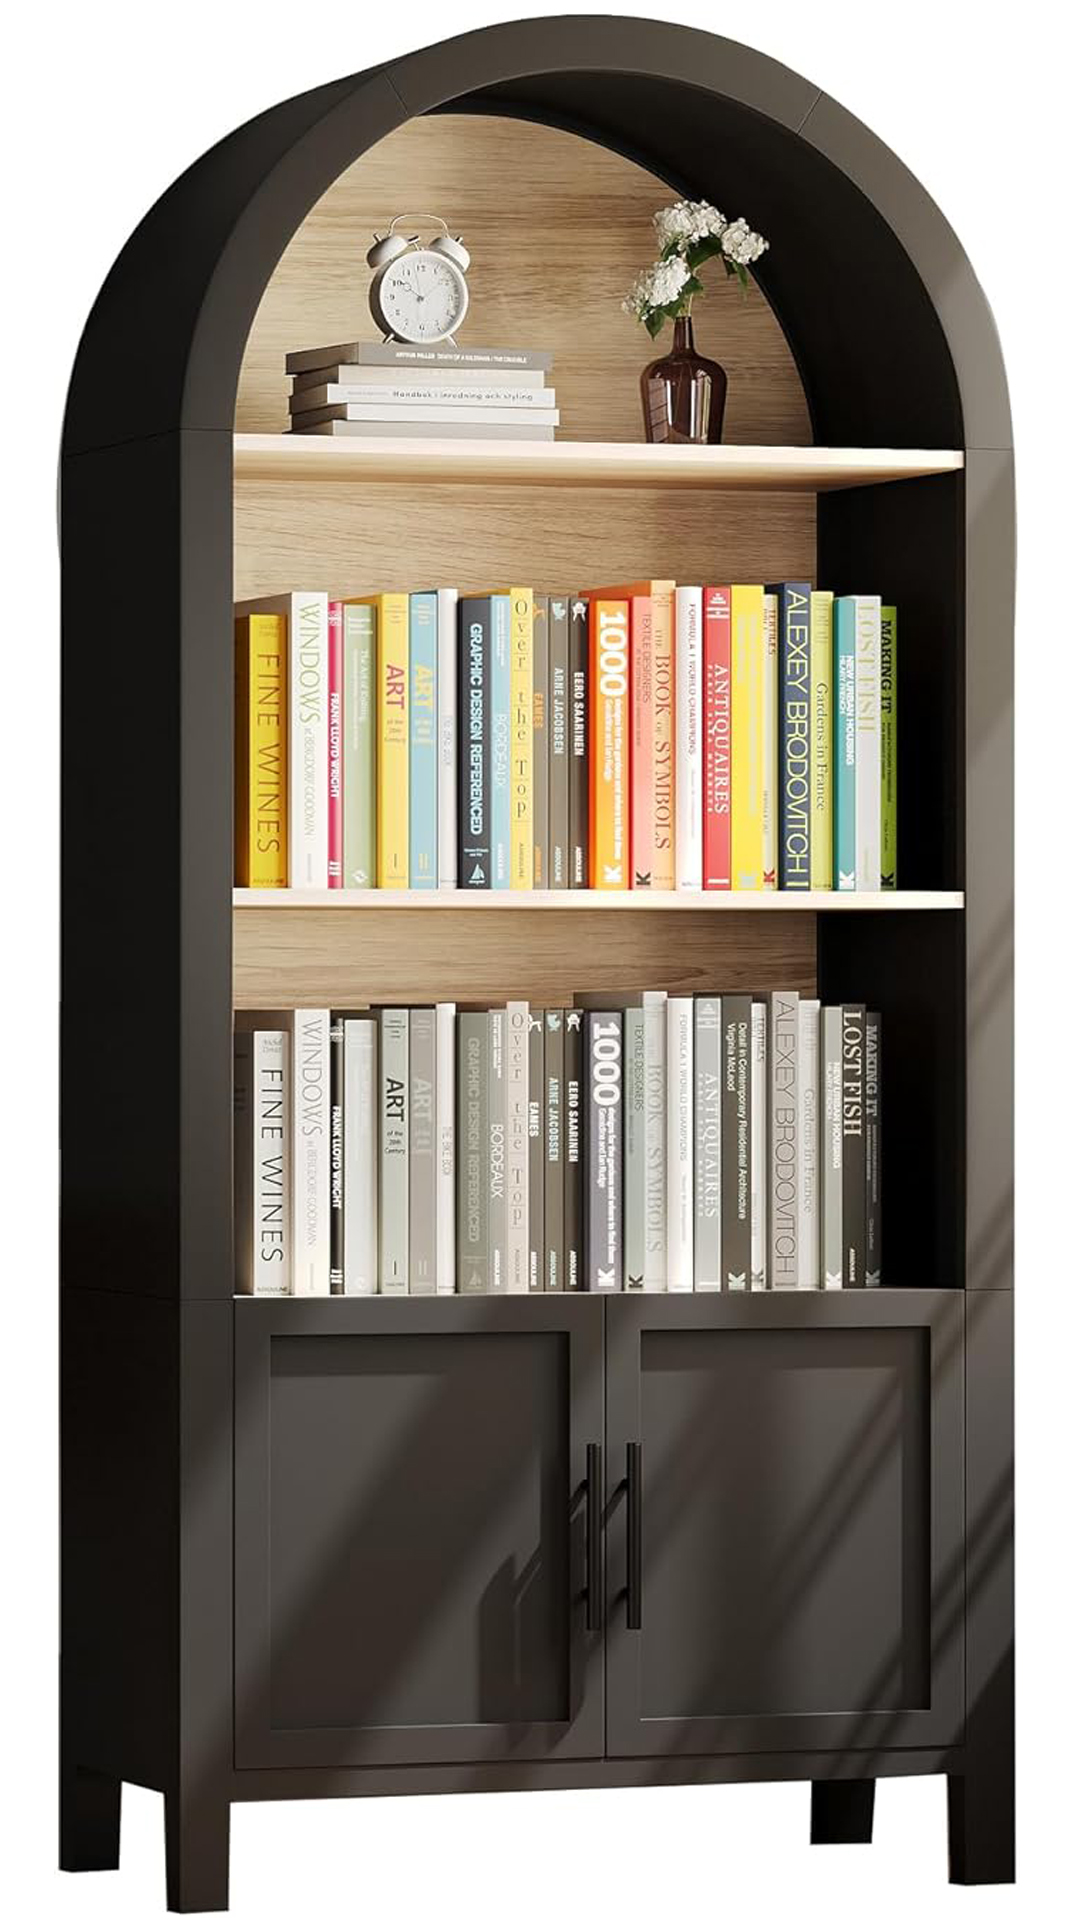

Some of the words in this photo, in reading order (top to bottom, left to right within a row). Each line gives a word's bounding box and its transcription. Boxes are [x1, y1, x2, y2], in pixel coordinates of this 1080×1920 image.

[642, 613, 652, 649] TEXTILE
[687, 603, 696, 650] FORMULA
[787, 590, 808, 694] ALEXEY
[858, 603, 876, 667] LOST
[299, 603, 321, 724] WINDOWS
[469, 623, 483, 687] GRAPHIC
[600, 611, 627, 697] 1000
[642, 651, 652, 703] DESIGNERS
[687, 660, 696, 695] WORLD
[846, 655, 854, 680] NEW
[881, 619, 892, 691] MAKING
[257, 653, 280, 727] FINE
[386, 664, 404, 710] ART
[415, 664, 434, 709] ART
[553, 668, 564, 695] ARNE
[574, 671, 585, 699] EERO
[655, 655, 670, 716] BOOK
[846, 681, 854, 716] URBAN
[858, 677, 876, 733] FISH
[881, 695, 892, 714] IT
[330, 693, 340, 724] FRANK
[469, 689, 483, 740] DESIGN
[533, 693, 544, 728] EAMES
[553, 699, 564, 754] JACOBSEN
[574, 701, 585, 756] SAARINEN
[687, 697, 696, 756] CHAMPIONS
[815, 683, 829, 741] Gardens
[330, 727, 340, 758] LLOYD
[494, 714, 507, 788] BORDEAUX
[711, 664, 730, 815] ANTIQUAIRES
[815, 744, 829, 759] in
[846, 718, 854, 766] HOUSING
[257, 743, 280, 853] WINES
[330, 759, 340, 798] WRIGHT
[469, 744, 483, 835] REFERENCED
[655, 741, 671, 850] SYMBOLS
[787, 701, 808, 873] BRODOVITCH
[815, 763, 829, 811] France
[634, 1024, 644, 1059] TEXTILE
[679, 1014, 688, 1059] FORMULA
[726, 1023, 737, 1055] Virginia
[737, 1022, 748, 1048] Detail
[774, 1000, 796, 1099] ALEXEY
[843, 1011, 862, 1076] LOST
[866, 1024, 878, 1095] MAKING
[301, 1020, 323, 1137] WINDOWS
[467, 1037, 480, 1097] GRAPHIC
[593, 1021, 621, 1106] 1000
[634, 1060, 644, 1111] DESIGNERS
[679, 1069, 688, 1104] WORLD
[726, 1057, 737, 1091] McLeod
[737, 1058, 748, 1118] Contemporary
[832, 1061, 841, 1085] NEW
[261, 1069, 283, 1139] FINE
[386, 1078, 404, 1122] ART
[413, 1077, 432, 1121] ART
[549, 1077, 559, 1105] ARNE
[568, 1080, 579, 1107] EERO
[647, 1065, 663, 1124] BOOK
[832, 1086, 841, 1122] URBAN
[843, 1080, 862, 1137] FISH
[866, 1098, 878, 1117] IT
[332, 1106, 342, 1137] FRANK
[467, 1101, 480, 1152] DESIGN
[528, 1102, 539, 1137] EAMES
[549, 1108, 559, 1161] JACOBSEN
[568, 1110, 579, 1162] SAARINEN
[679, 1106, 688, 1161] CHAMPIONS
[803, 1088, 815, 1147] Gardens
[332, 1138, 342, 1170] LLOYD
[491, 1124, 504, 1199] BORDEAUX
[702, 1073, 718, 1218] ANTIQUAIRES
[737, 1120, 748, 1168] Residential
[803, 1150, 815, 1162] in
[832, 1123, 841, 1169] HOUSING
[261, 1156, 283, 1262] WINES
[332, 1171, 342, 1210] WRIGHT
[467, 1154, 480, 1242] REFERENCED
[647, 1147, 663, 1253] SYMBOLS
[737, 1168, 748, 1220] Architecture
[774, 1107, 796, 1273] BRODOVITCH
[803, 1168, 815, 1213] France
